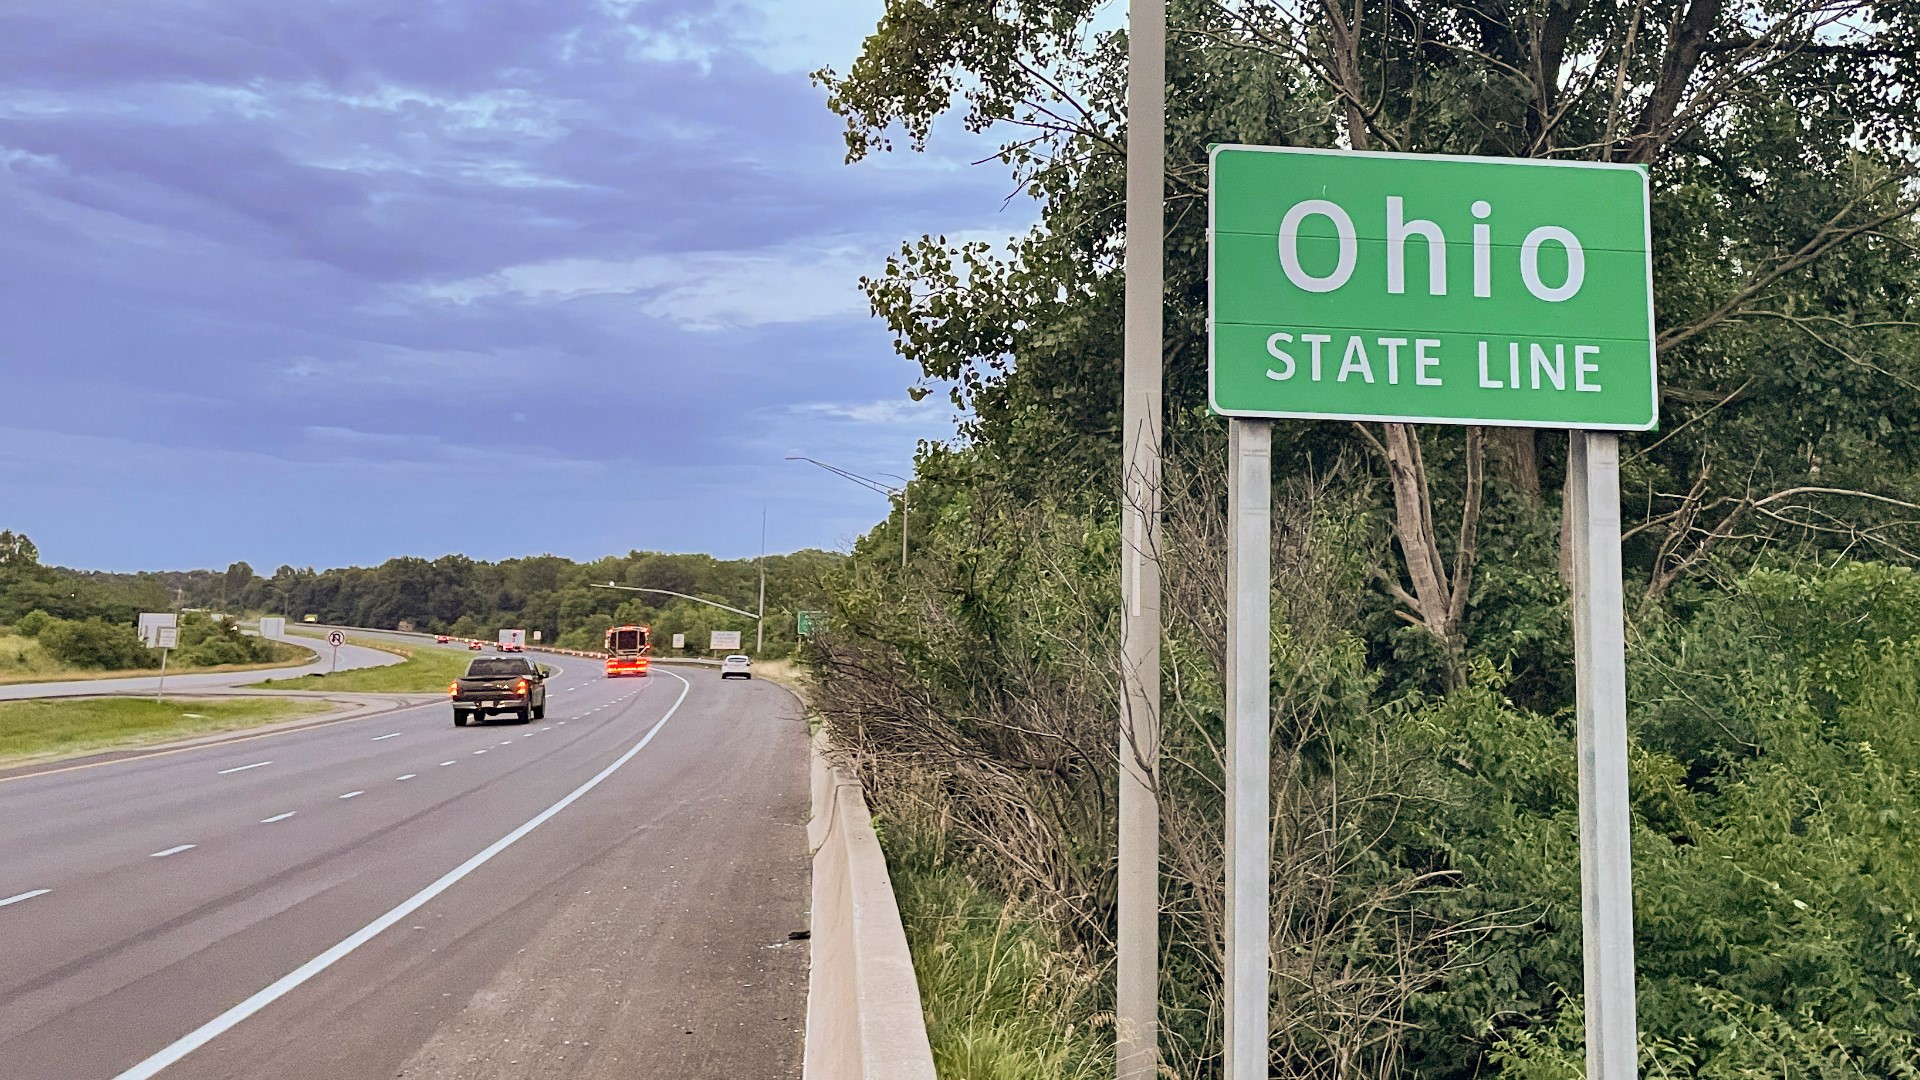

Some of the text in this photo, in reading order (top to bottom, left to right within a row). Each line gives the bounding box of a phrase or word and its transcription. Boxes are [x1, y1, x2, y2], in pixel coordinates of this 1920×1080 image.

[1278, 196, 1585, 302] Ohio
[1265, 333, 1602, 392] STATE LINE
